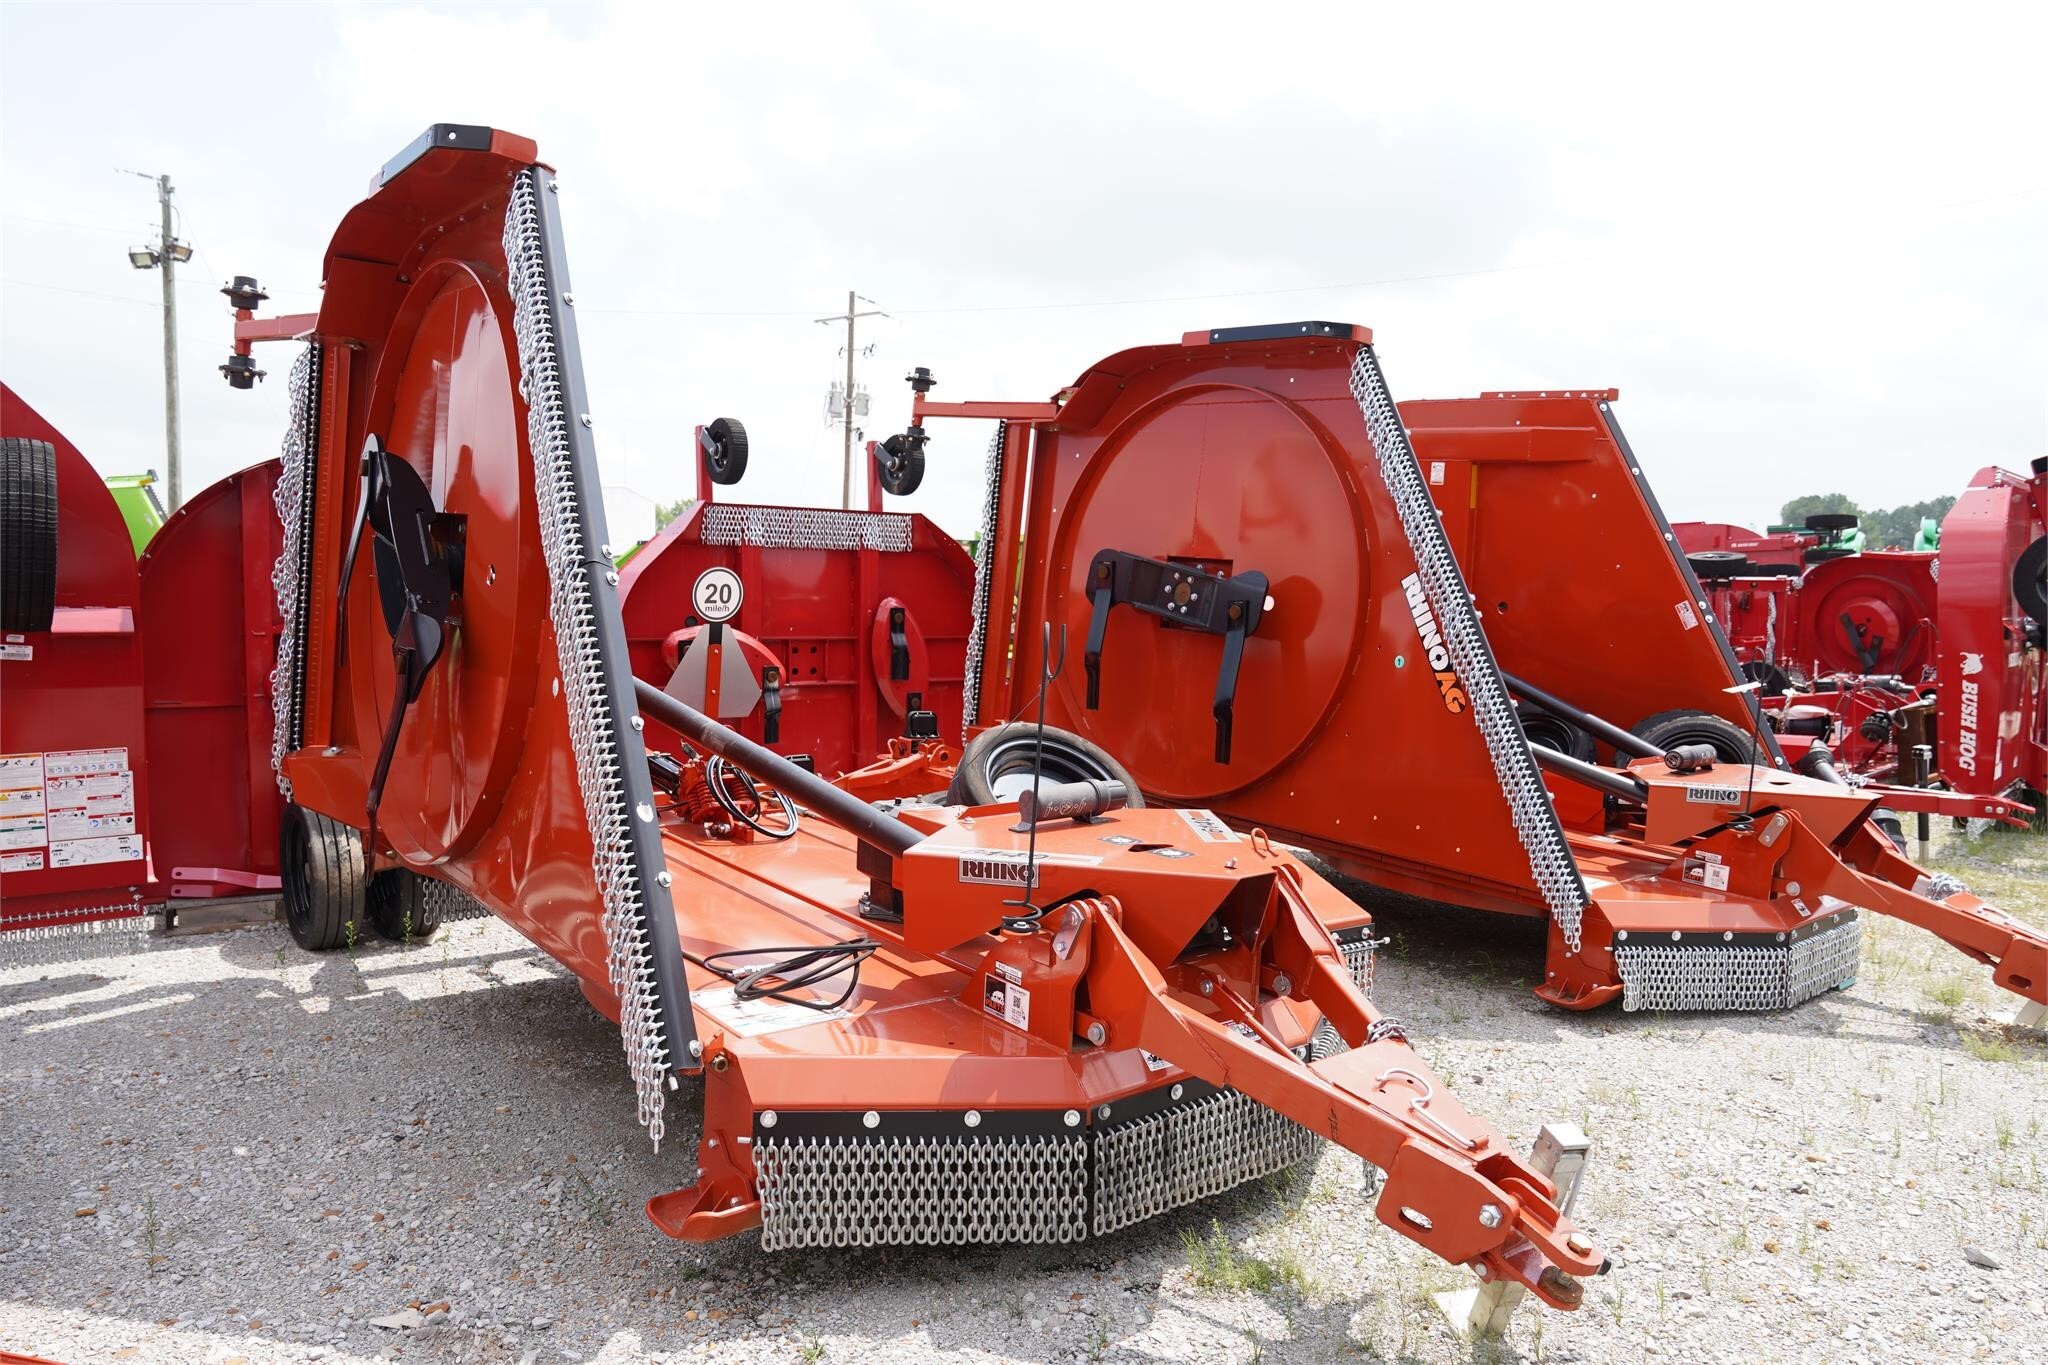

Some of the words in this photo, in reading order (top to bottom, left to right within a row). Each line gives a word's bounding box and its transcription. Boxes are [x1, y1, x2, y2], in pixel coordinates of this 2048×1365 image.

[704, 583, 732, 604] 20
[705, 604, 730, 612] mile/h
[1960, 679, 1979, 729] BUSH
[1958, 729, 1977, 773] HOG
[1688, 788, 1738, 802] RHINO
[962, 860, 1036, 883] RHINO
